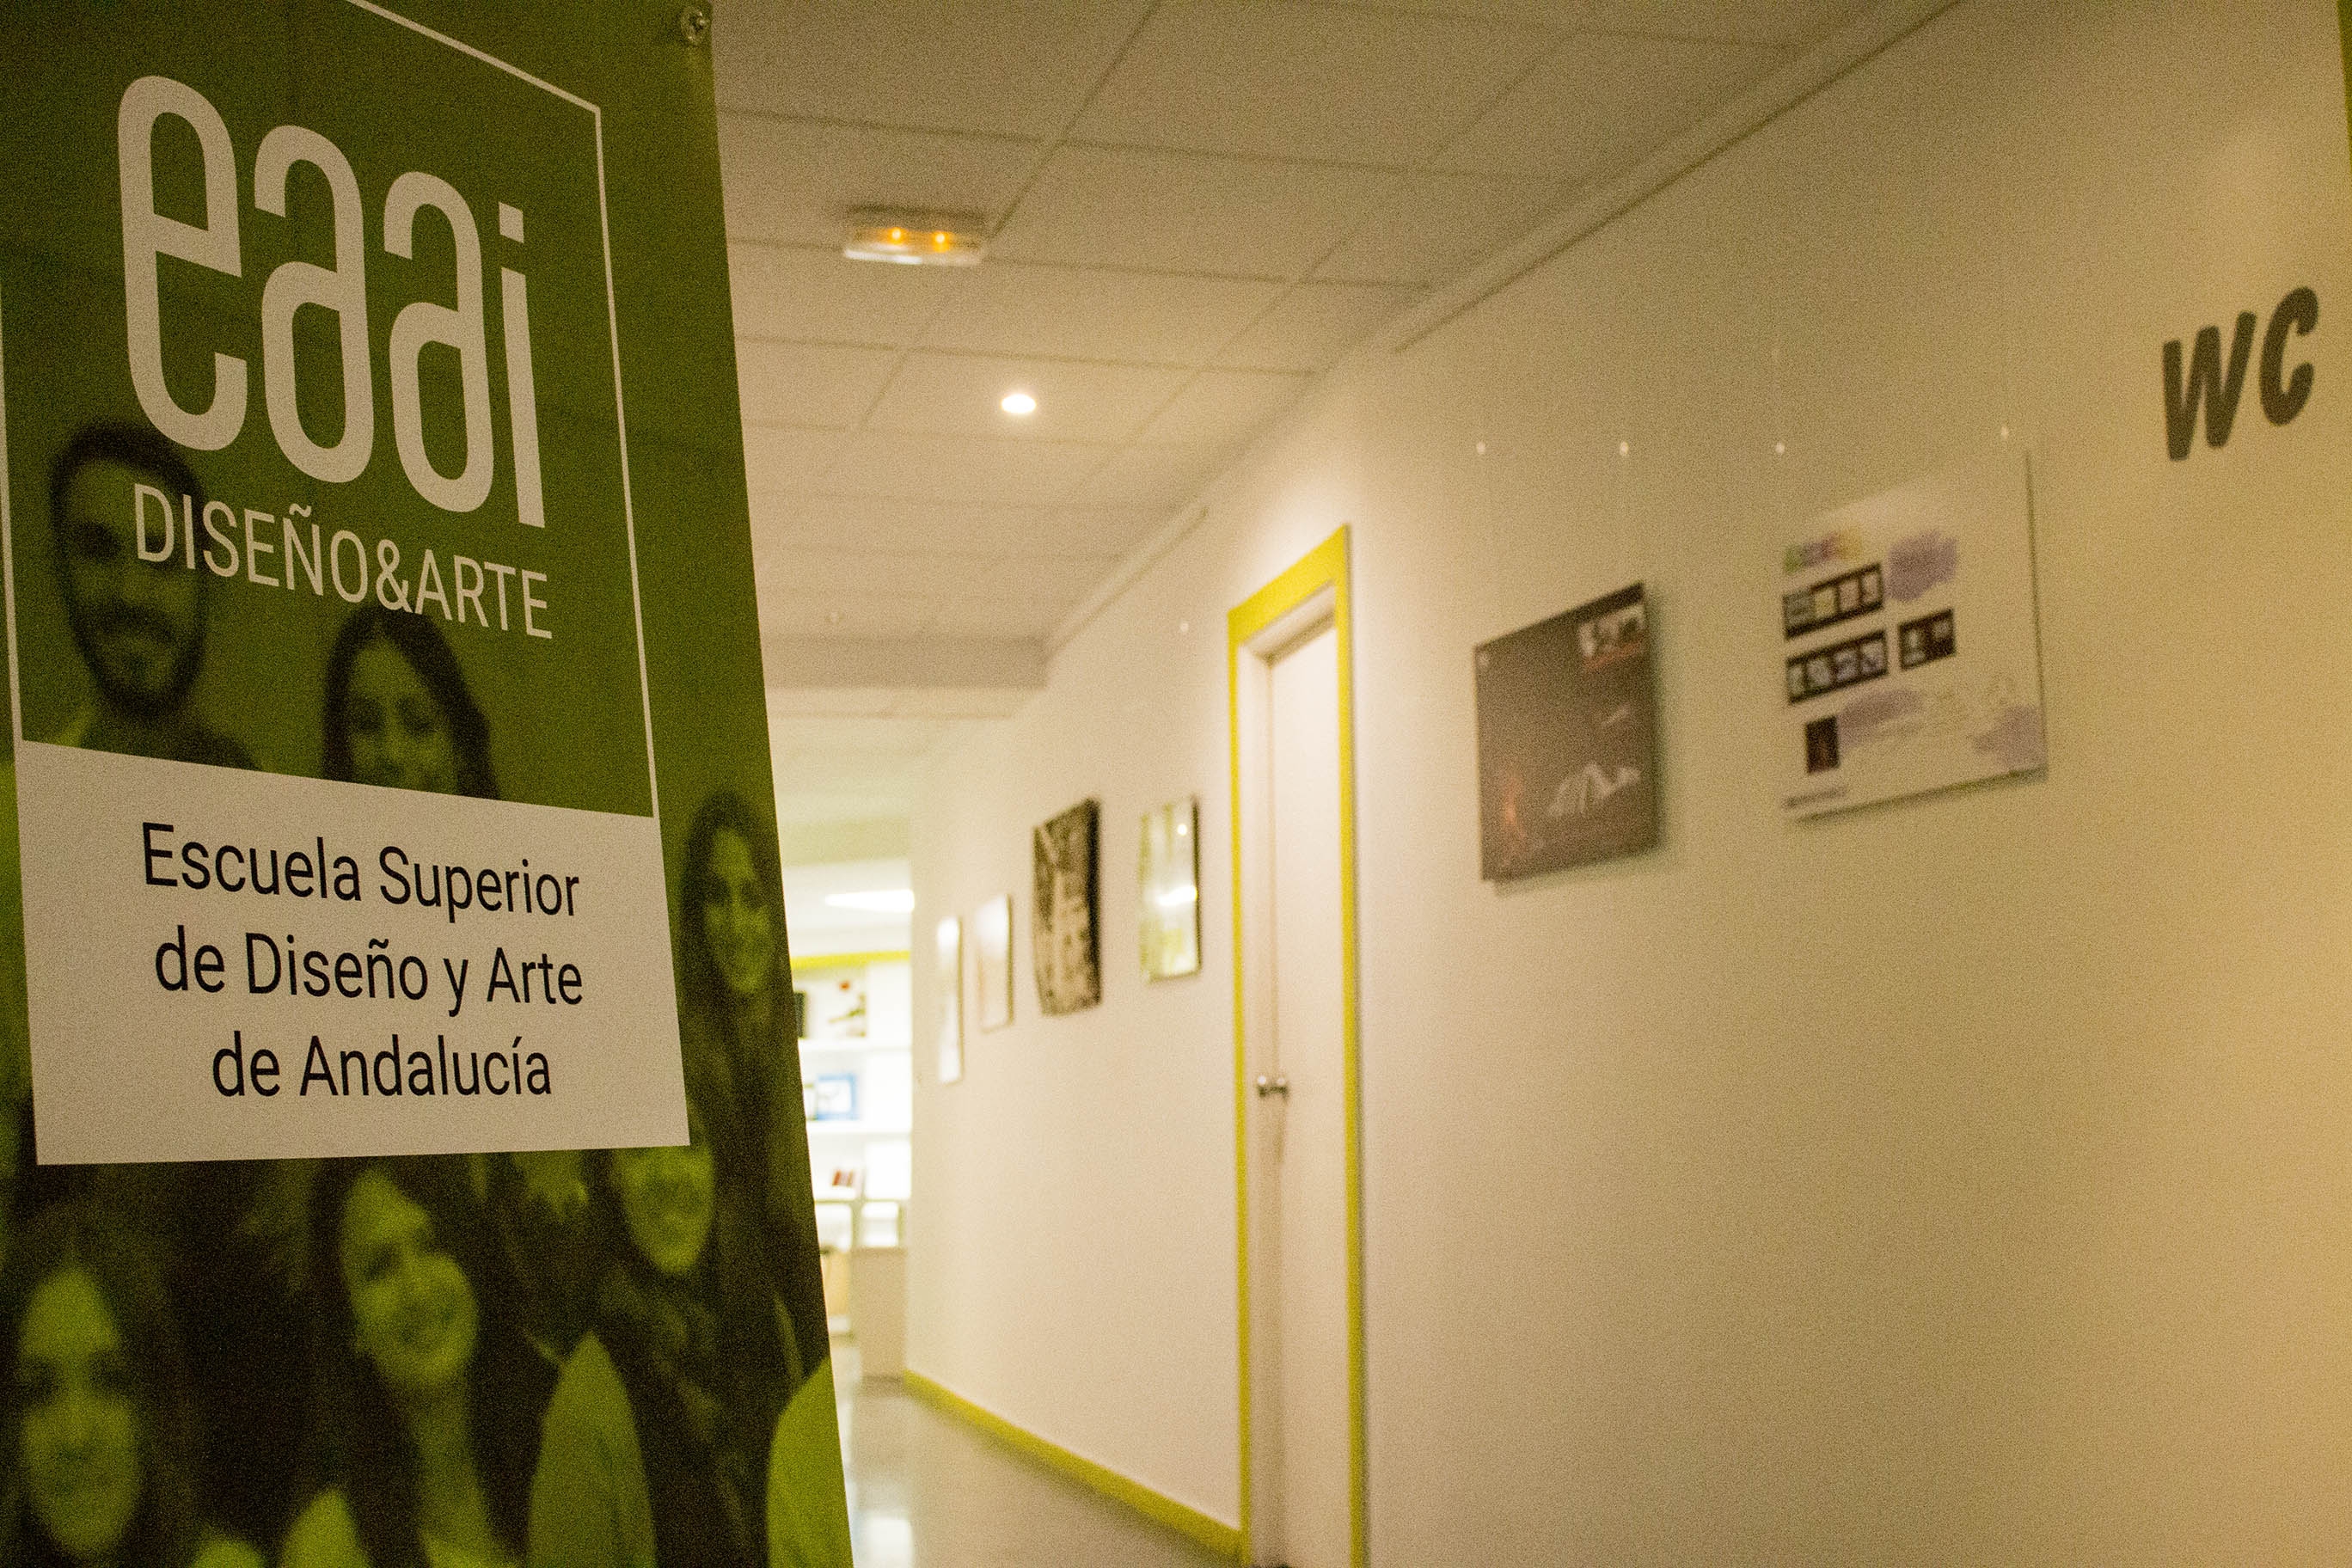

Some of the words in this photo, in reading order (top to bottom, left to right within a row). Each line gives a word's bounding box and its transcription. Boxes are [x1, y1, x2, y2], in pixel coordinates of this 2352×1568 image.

[118, 76, 545, 528] eaai
[2162, 285, 2318, 462] WC
[134, 483, 553, 640] DISEÑO&ARTE
[142, 822, 361, 902] Escuela
[379, 846, 579, 922] Superior
[156, 925, 224, 993] de
[246, 932, 428, 1001] Diseño
[444, 958, 469, 1017] y
[487, 946, 584, 1005] Arte
[211, 1031, 280, 1097] de
[300, 1034, 552, 1097] Andalucía
